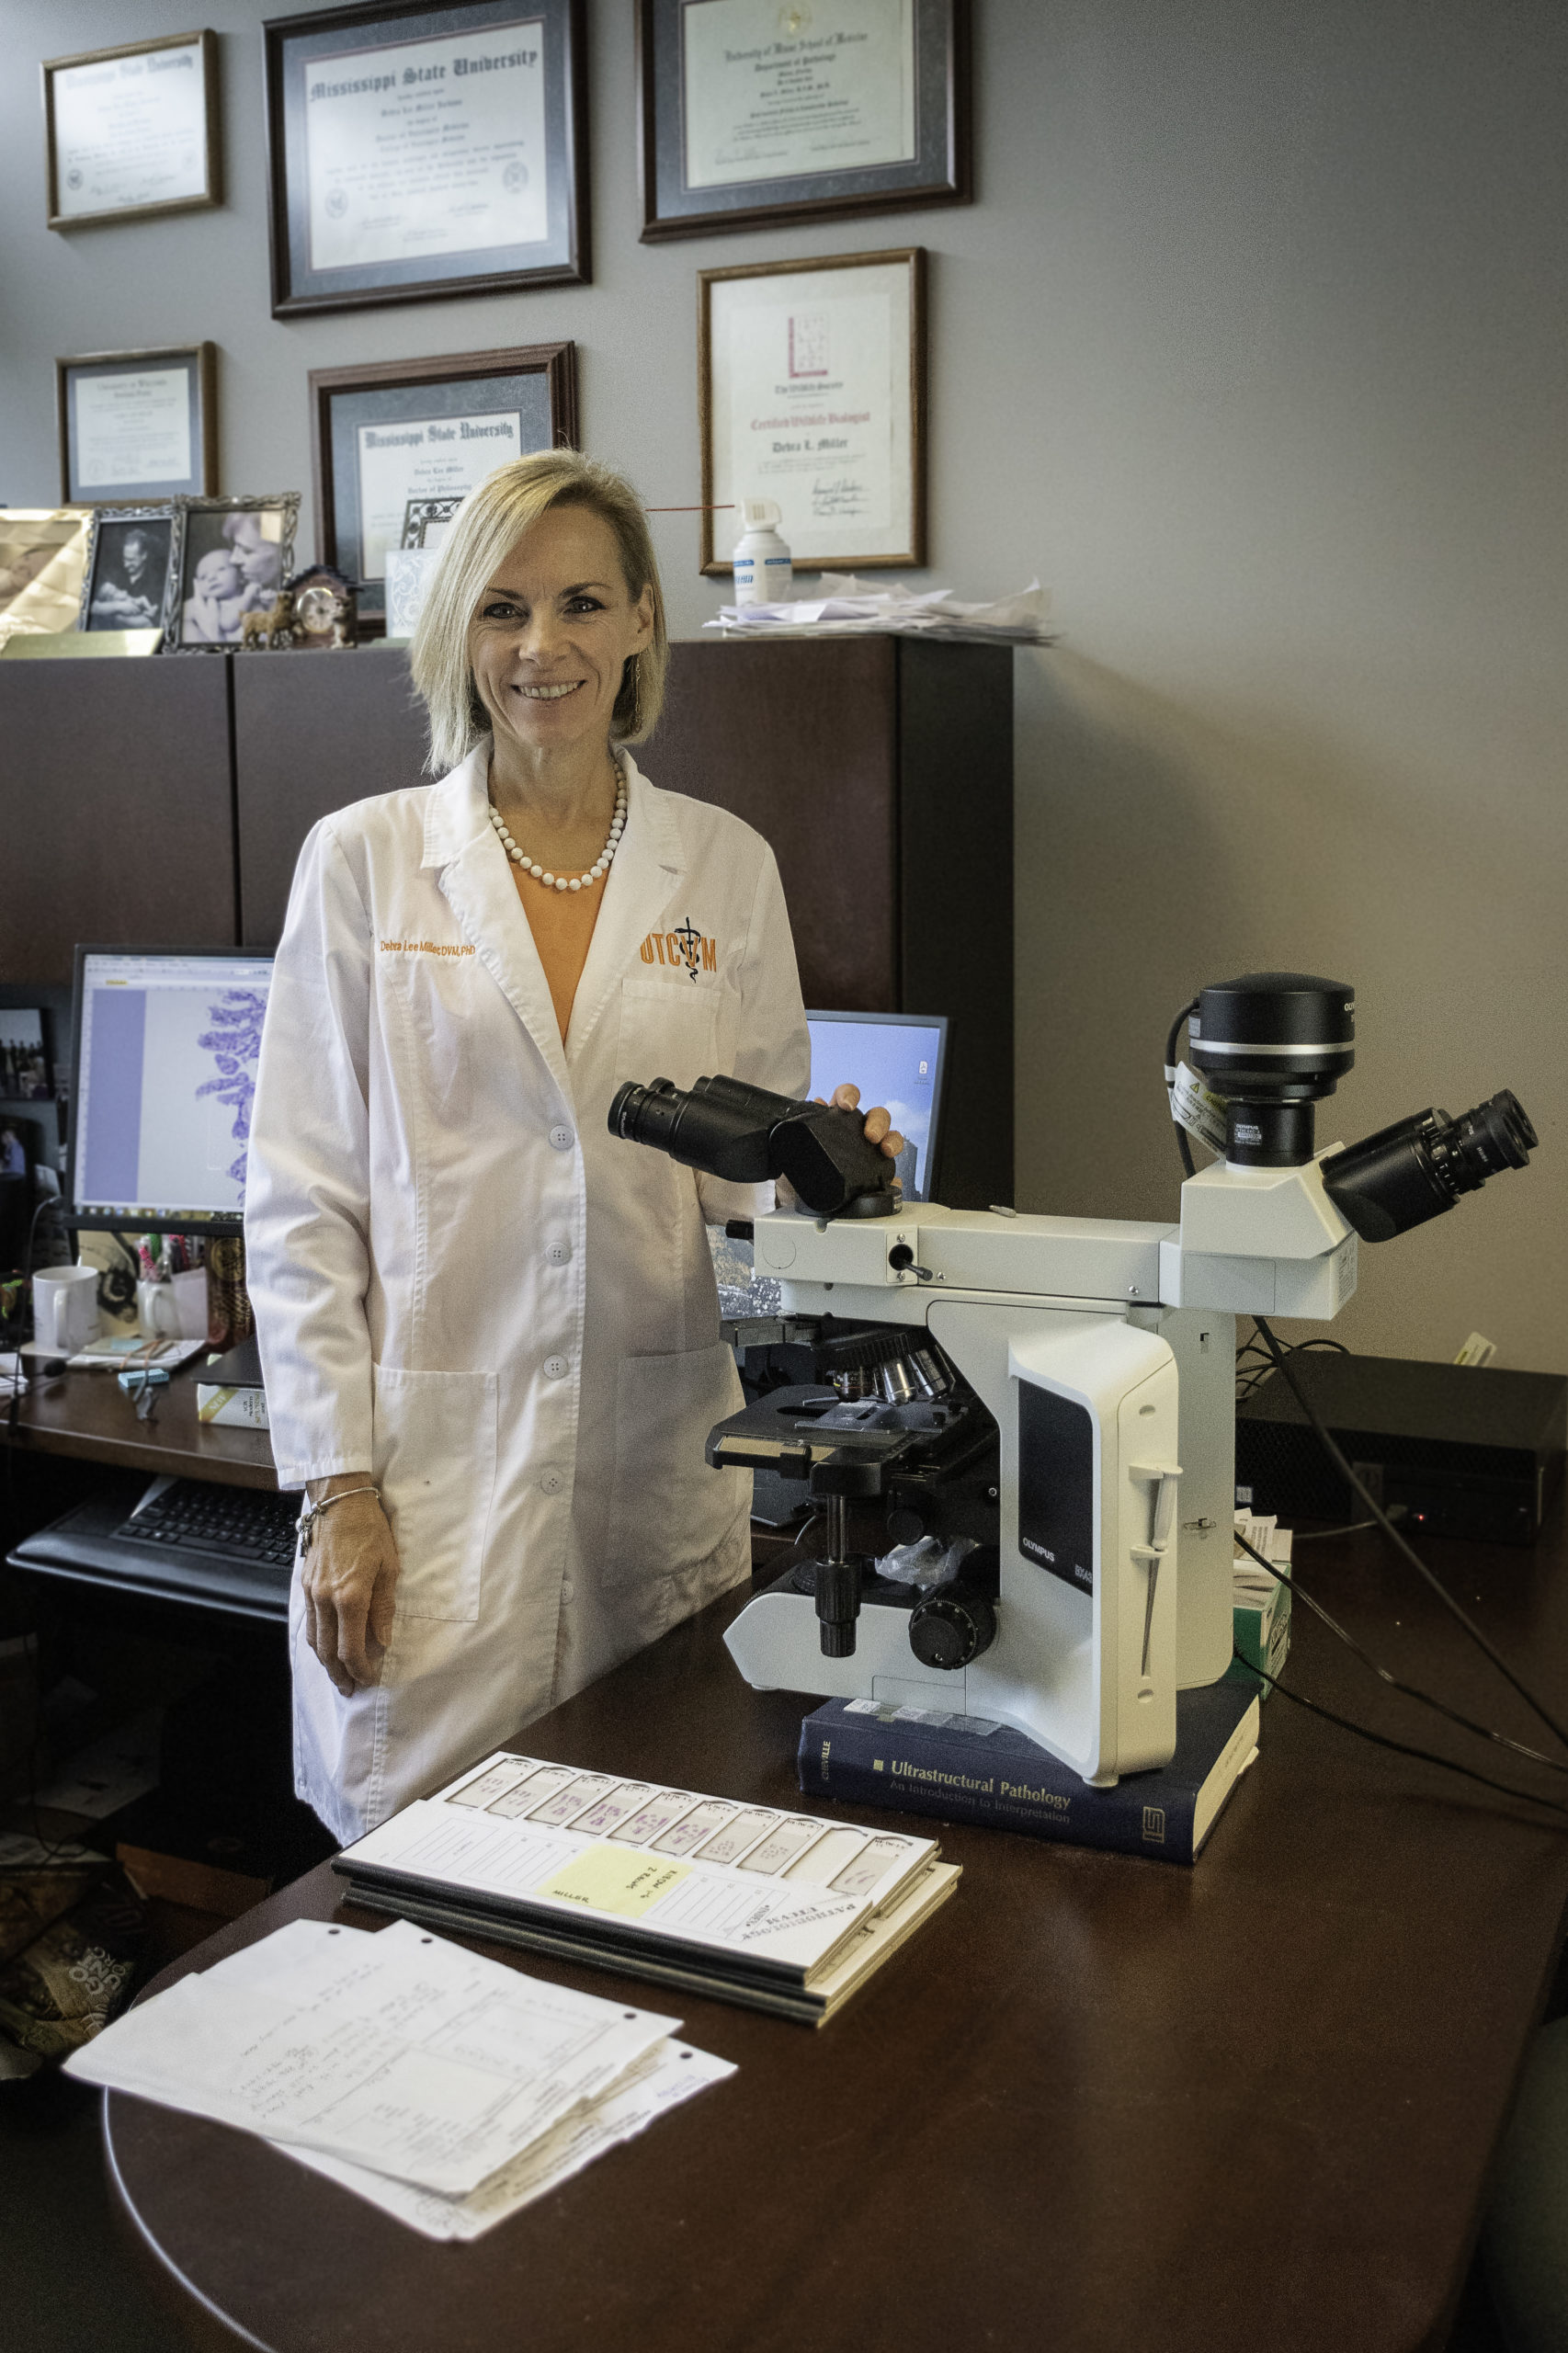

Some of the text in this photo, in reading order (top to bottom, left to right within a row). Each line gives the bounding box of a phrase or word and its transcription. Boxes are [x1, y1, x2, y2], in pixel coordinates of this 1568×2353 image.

[309, 73, 396, 102] Mississippi
[402, 65, 447, 85] State
[453, 49, 539, 77] University
[427, 424, 457, 443] State
[460, 421, 515, 440] University
[381, 939, 402, 951] Debra
[403, 939, 419, 952] Lee
[1022, 1537, 1055, 1562] OLYMPUS
[892, 1760, 1072, 1811] Ultrastructural Pathology
[890, 1779, 1072, 1824] An Introduction to Interpretation
[552, 1889, 589, 1904] MILLER
